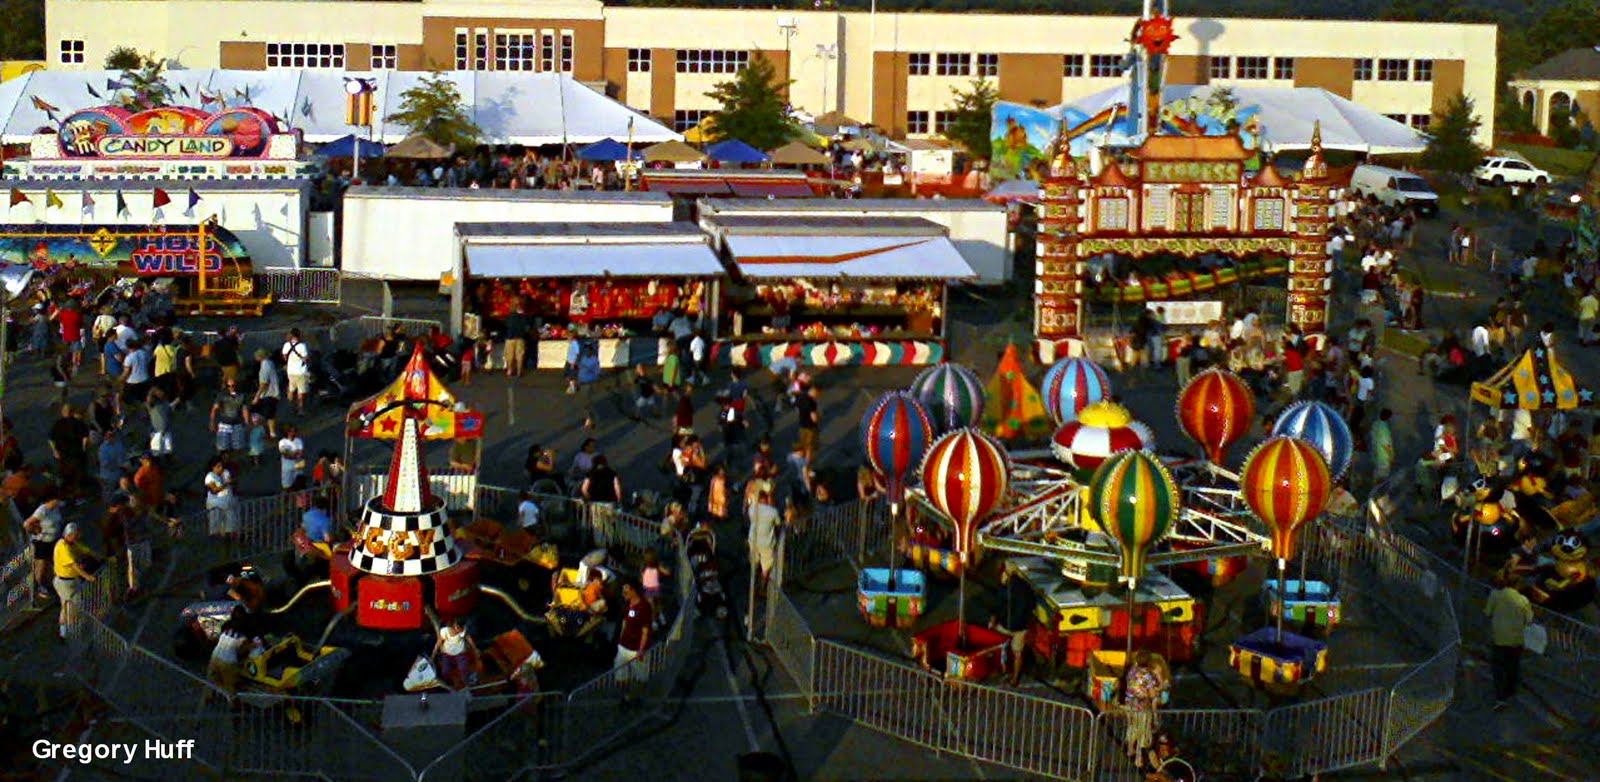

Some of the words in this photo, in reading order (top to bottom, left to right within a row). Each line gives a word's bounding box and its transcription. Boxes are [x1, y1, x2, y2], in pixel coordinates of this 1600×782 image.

[104, 138, 174, 154] CANDY
[179, 139, 225, 154] LAND
[132, 253, 222, 273] WILD
